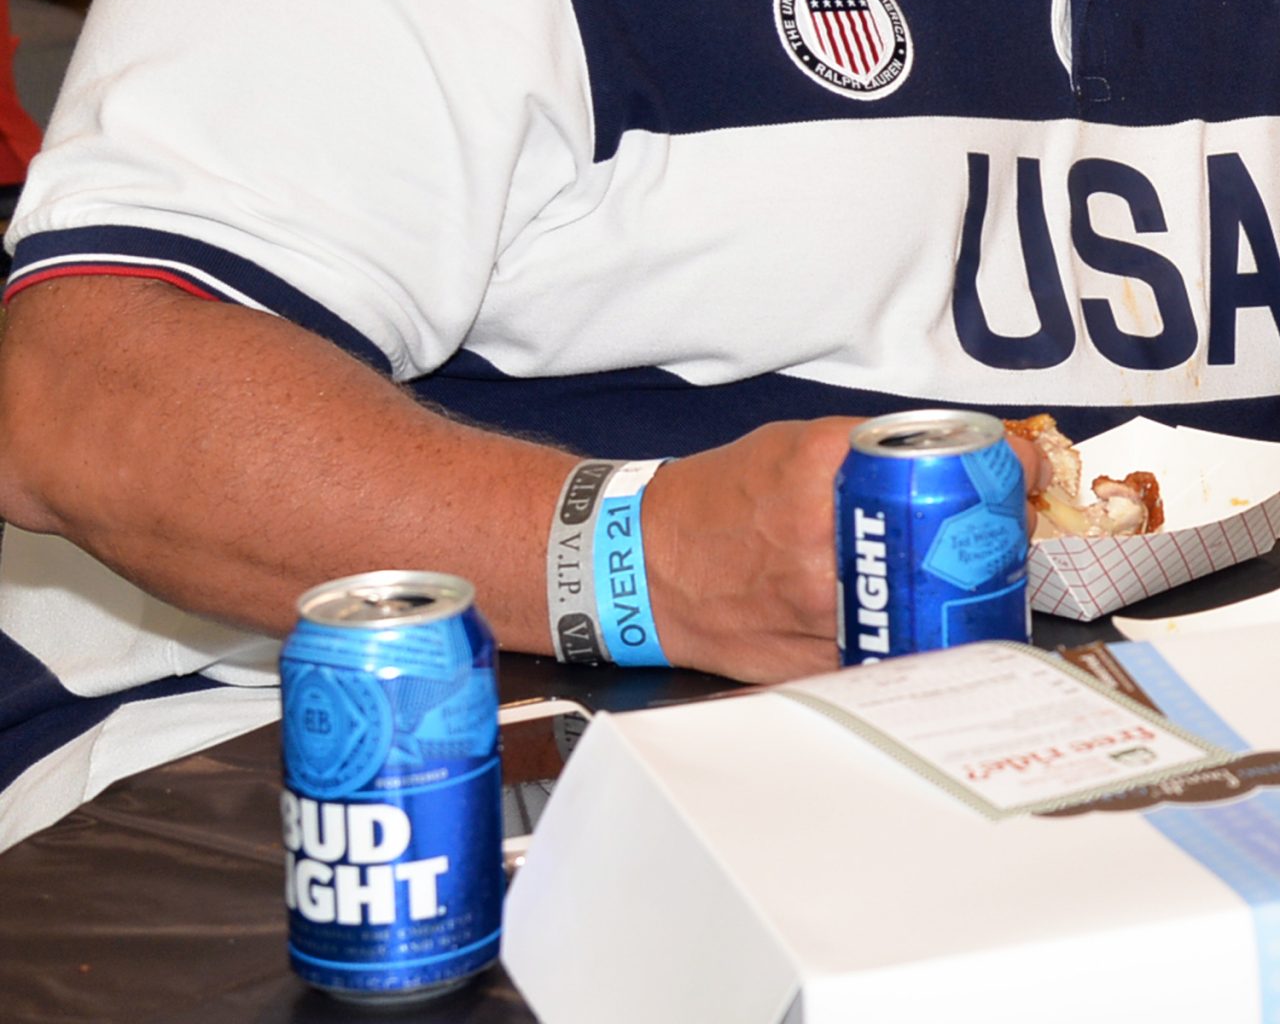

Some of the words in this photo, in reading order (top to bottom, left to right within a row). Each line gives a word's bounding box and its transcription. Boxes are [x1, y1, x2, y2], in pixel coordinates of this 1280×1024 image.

[781, 20, 803, 51] THE
[814, 63, 862, 90] RALPH
[563, 465, 608, 519] V.I.P.
[606, 503, 633, 540] 21
[557, 532, 583, 603] V.I.P.
[608, 546, 648, 648] OVER
[281, 790, 411, 863] BUD
[285, 854, 450, 925] IGHT
